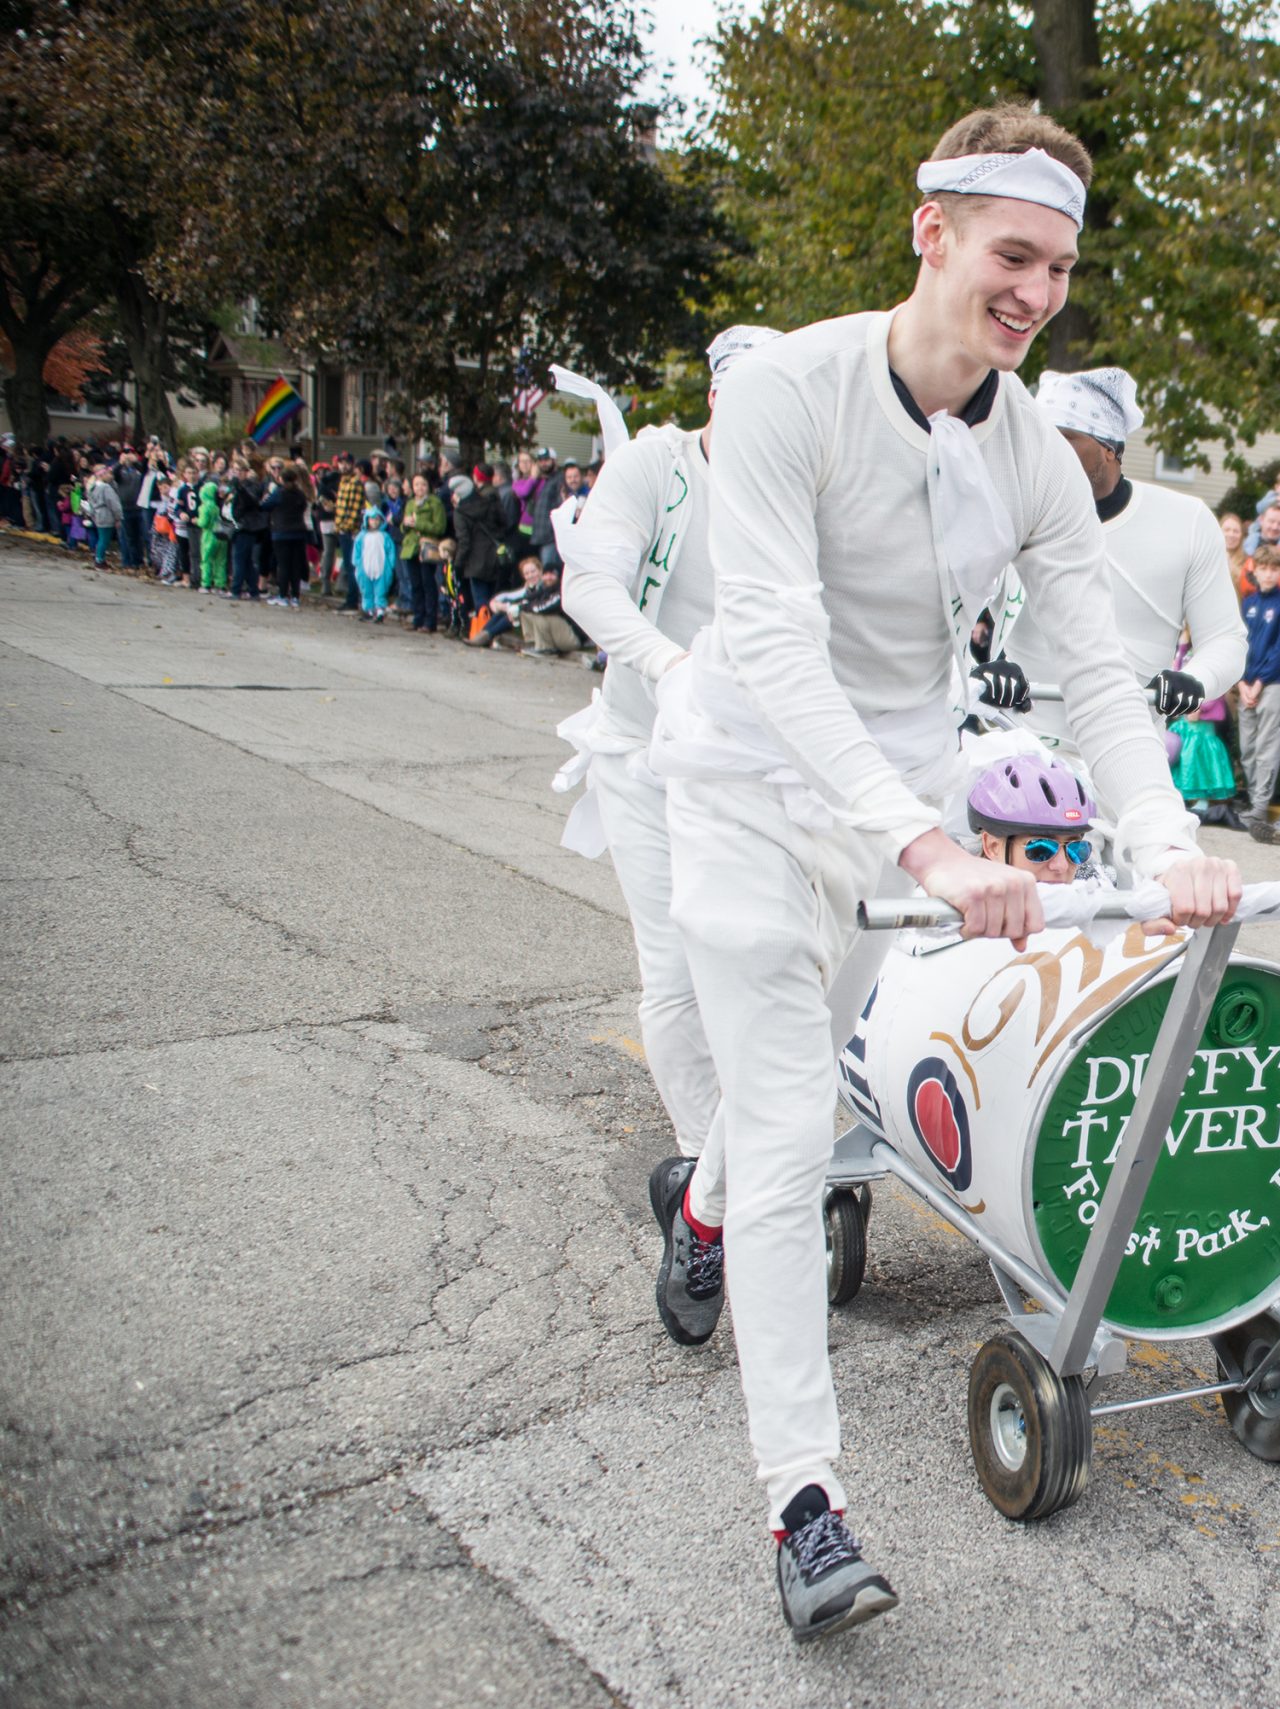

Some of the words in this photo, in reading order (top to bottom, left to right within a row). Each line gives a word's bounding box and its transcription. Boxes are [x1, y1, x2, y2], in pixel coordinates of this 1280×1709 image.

[187, 491, 197, 510] 6
[1062, 1167, 1161, 1266] Fost
[1173, 1208, 1271, 1262] Park,
